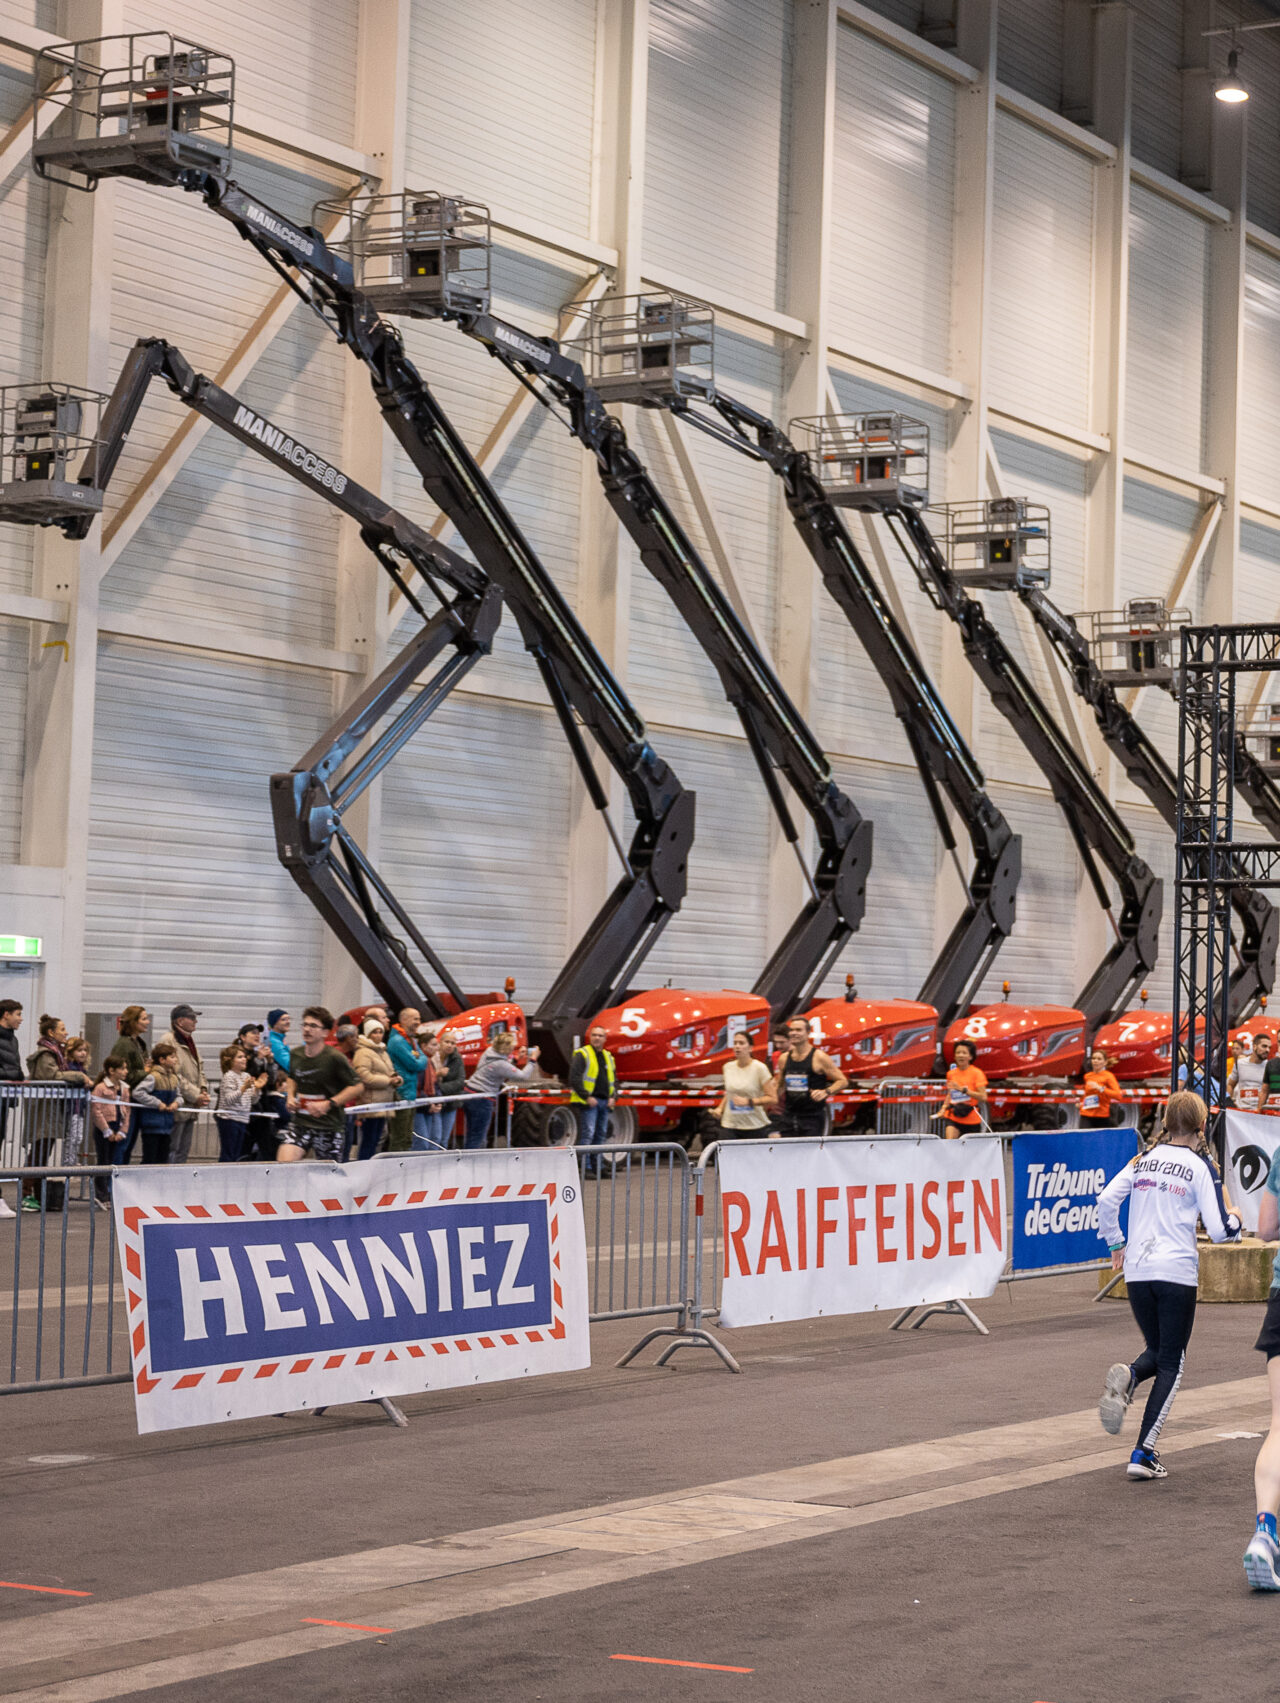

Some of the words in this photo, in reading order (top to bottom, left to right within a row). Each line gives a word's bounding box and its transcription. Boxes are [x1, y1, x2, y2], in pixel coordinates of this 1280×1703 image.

[247, 205, 314, 256] MANIACCESS
[233, 405, 348, 494] MANIACCESS
[620, 1008, 649, 1038] 5
[963, 1016, 988, 1038] 8
[1118, 1021, 1140, 1042] 7
[1026, 1162, 1106, 1199] Tribune
[1168, 1184, 1187, 1197] UBS
[721, 1178, 1003, 1279] RAIFFEISEN
[175, 1223, 536, 1341] HENNIEZ
